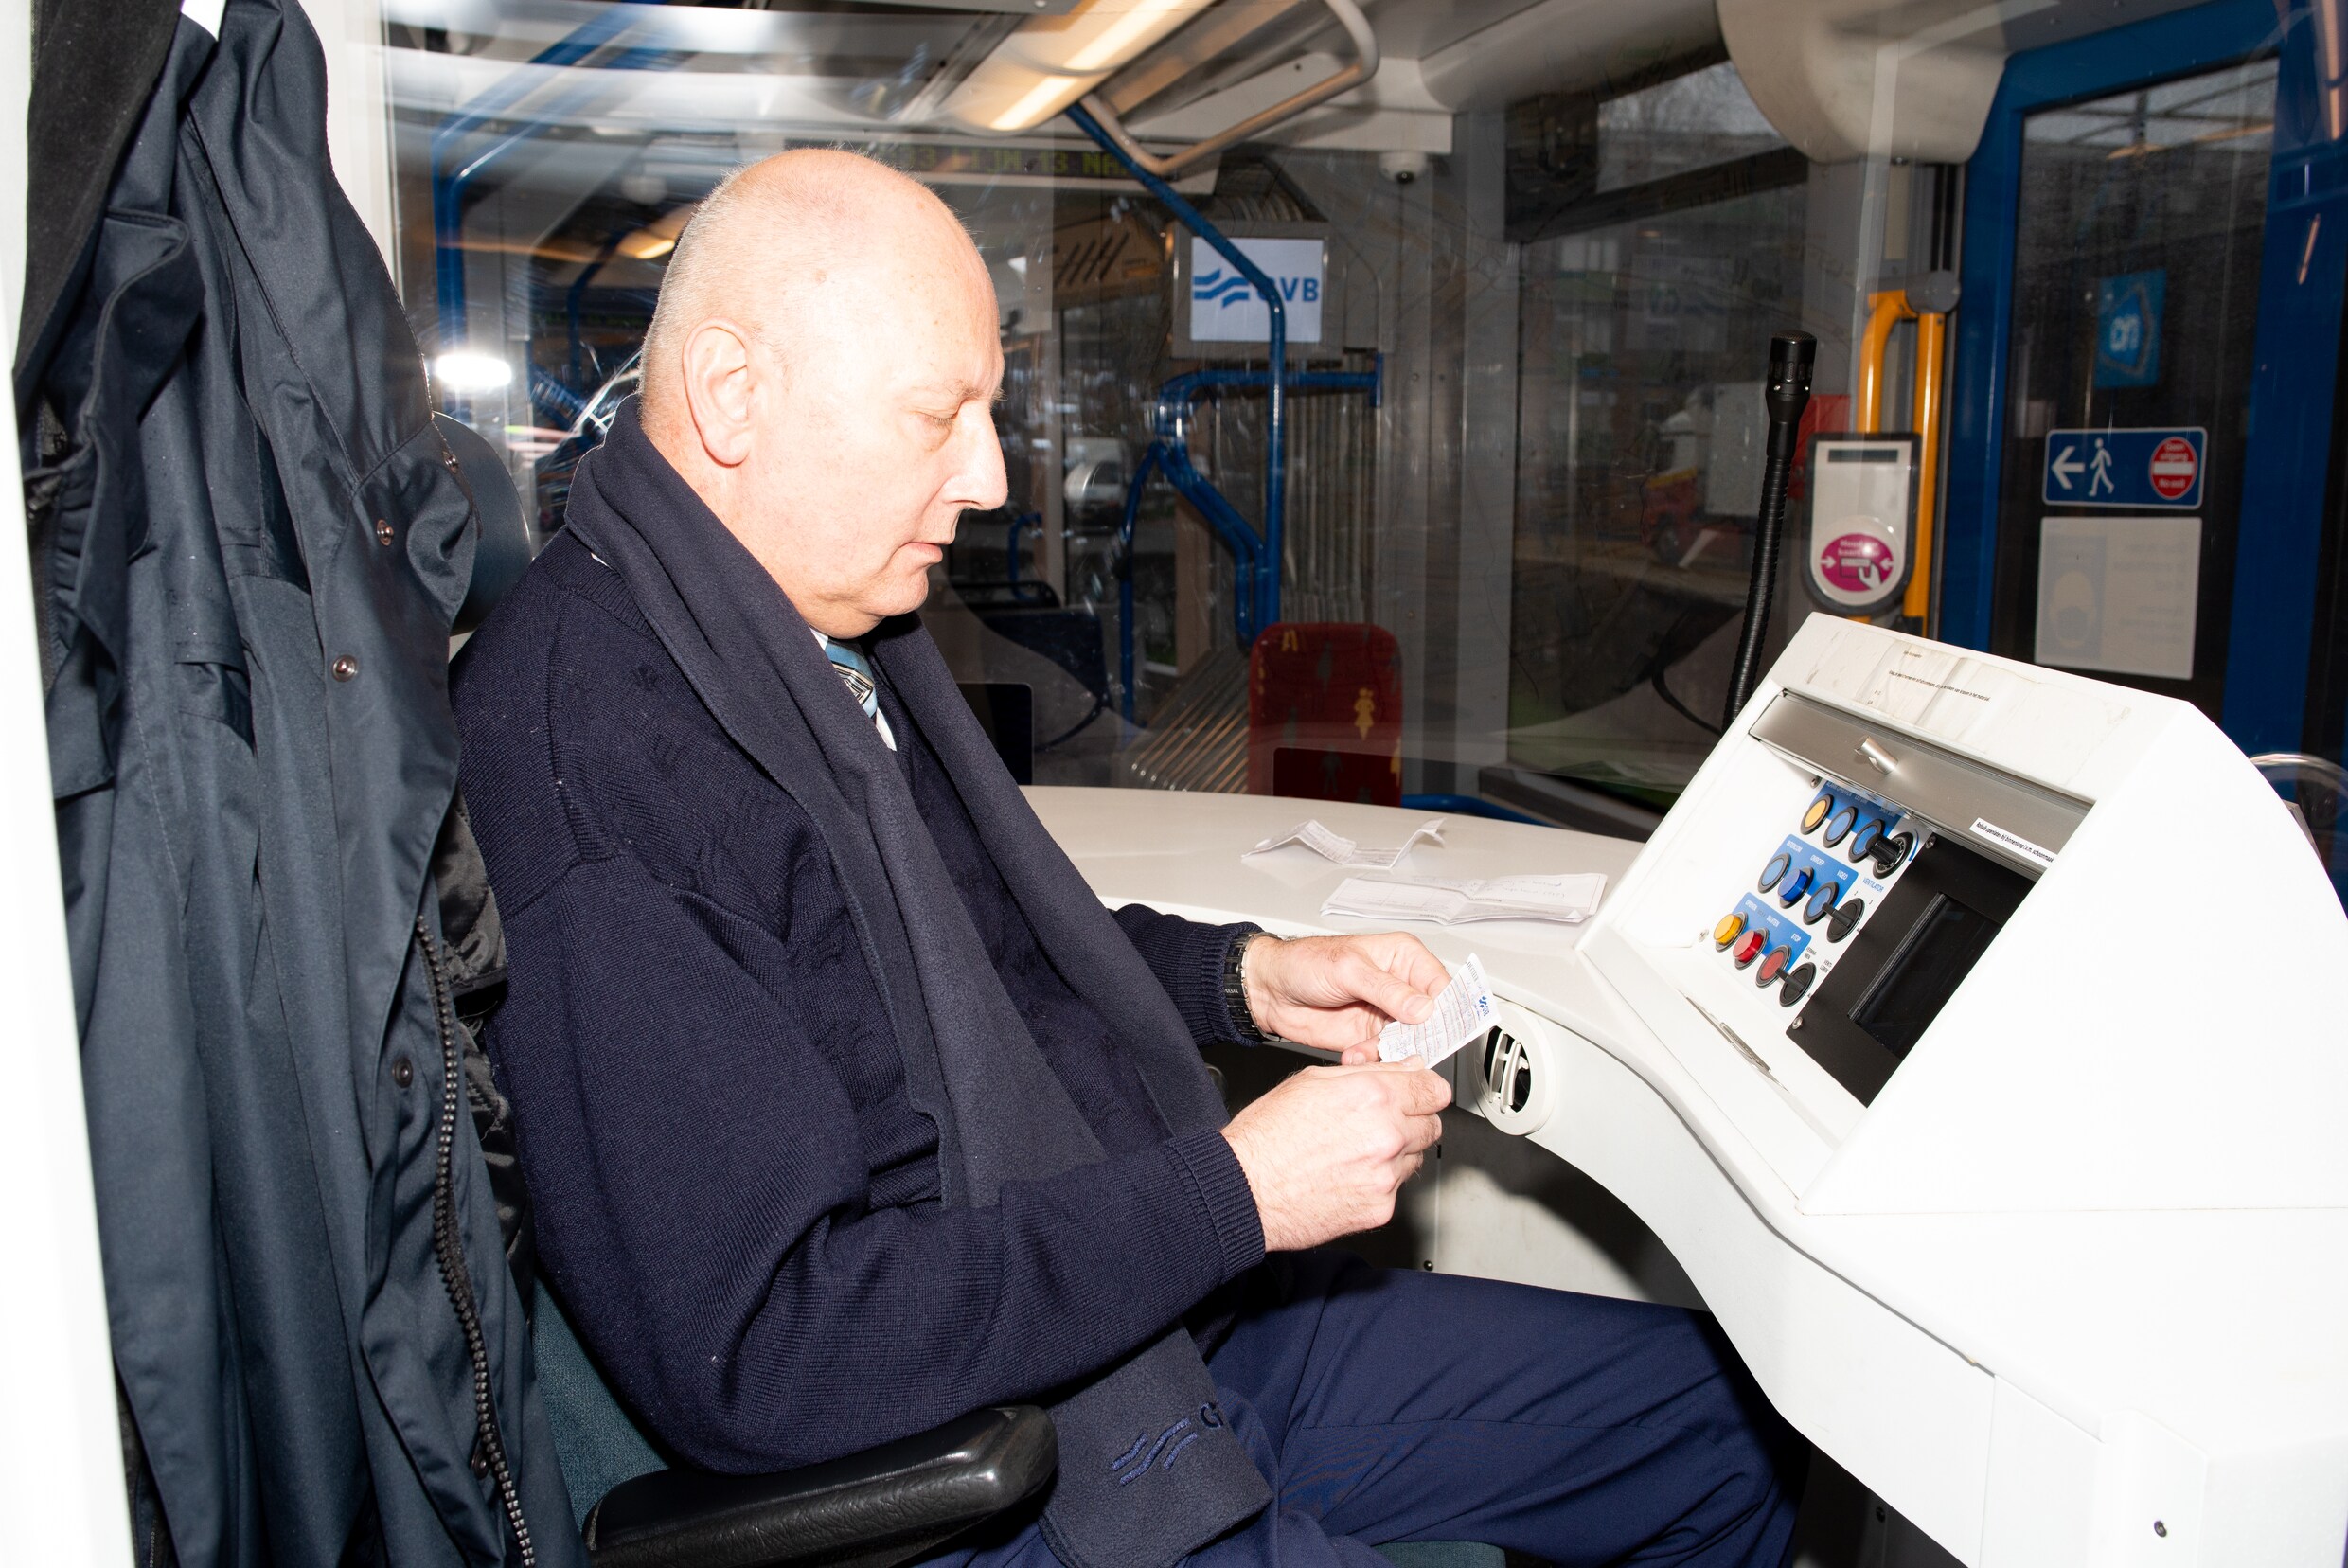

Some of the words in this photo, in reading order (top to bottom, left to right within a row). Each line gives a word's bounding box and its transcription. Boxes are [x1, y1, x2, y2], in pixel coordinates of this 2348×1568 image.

[1836, 869, 1849, 881] VIDEO
[1862, 877, 1885, 893] VENTILATOR
[1790, 933, 1802, 943] STOP
